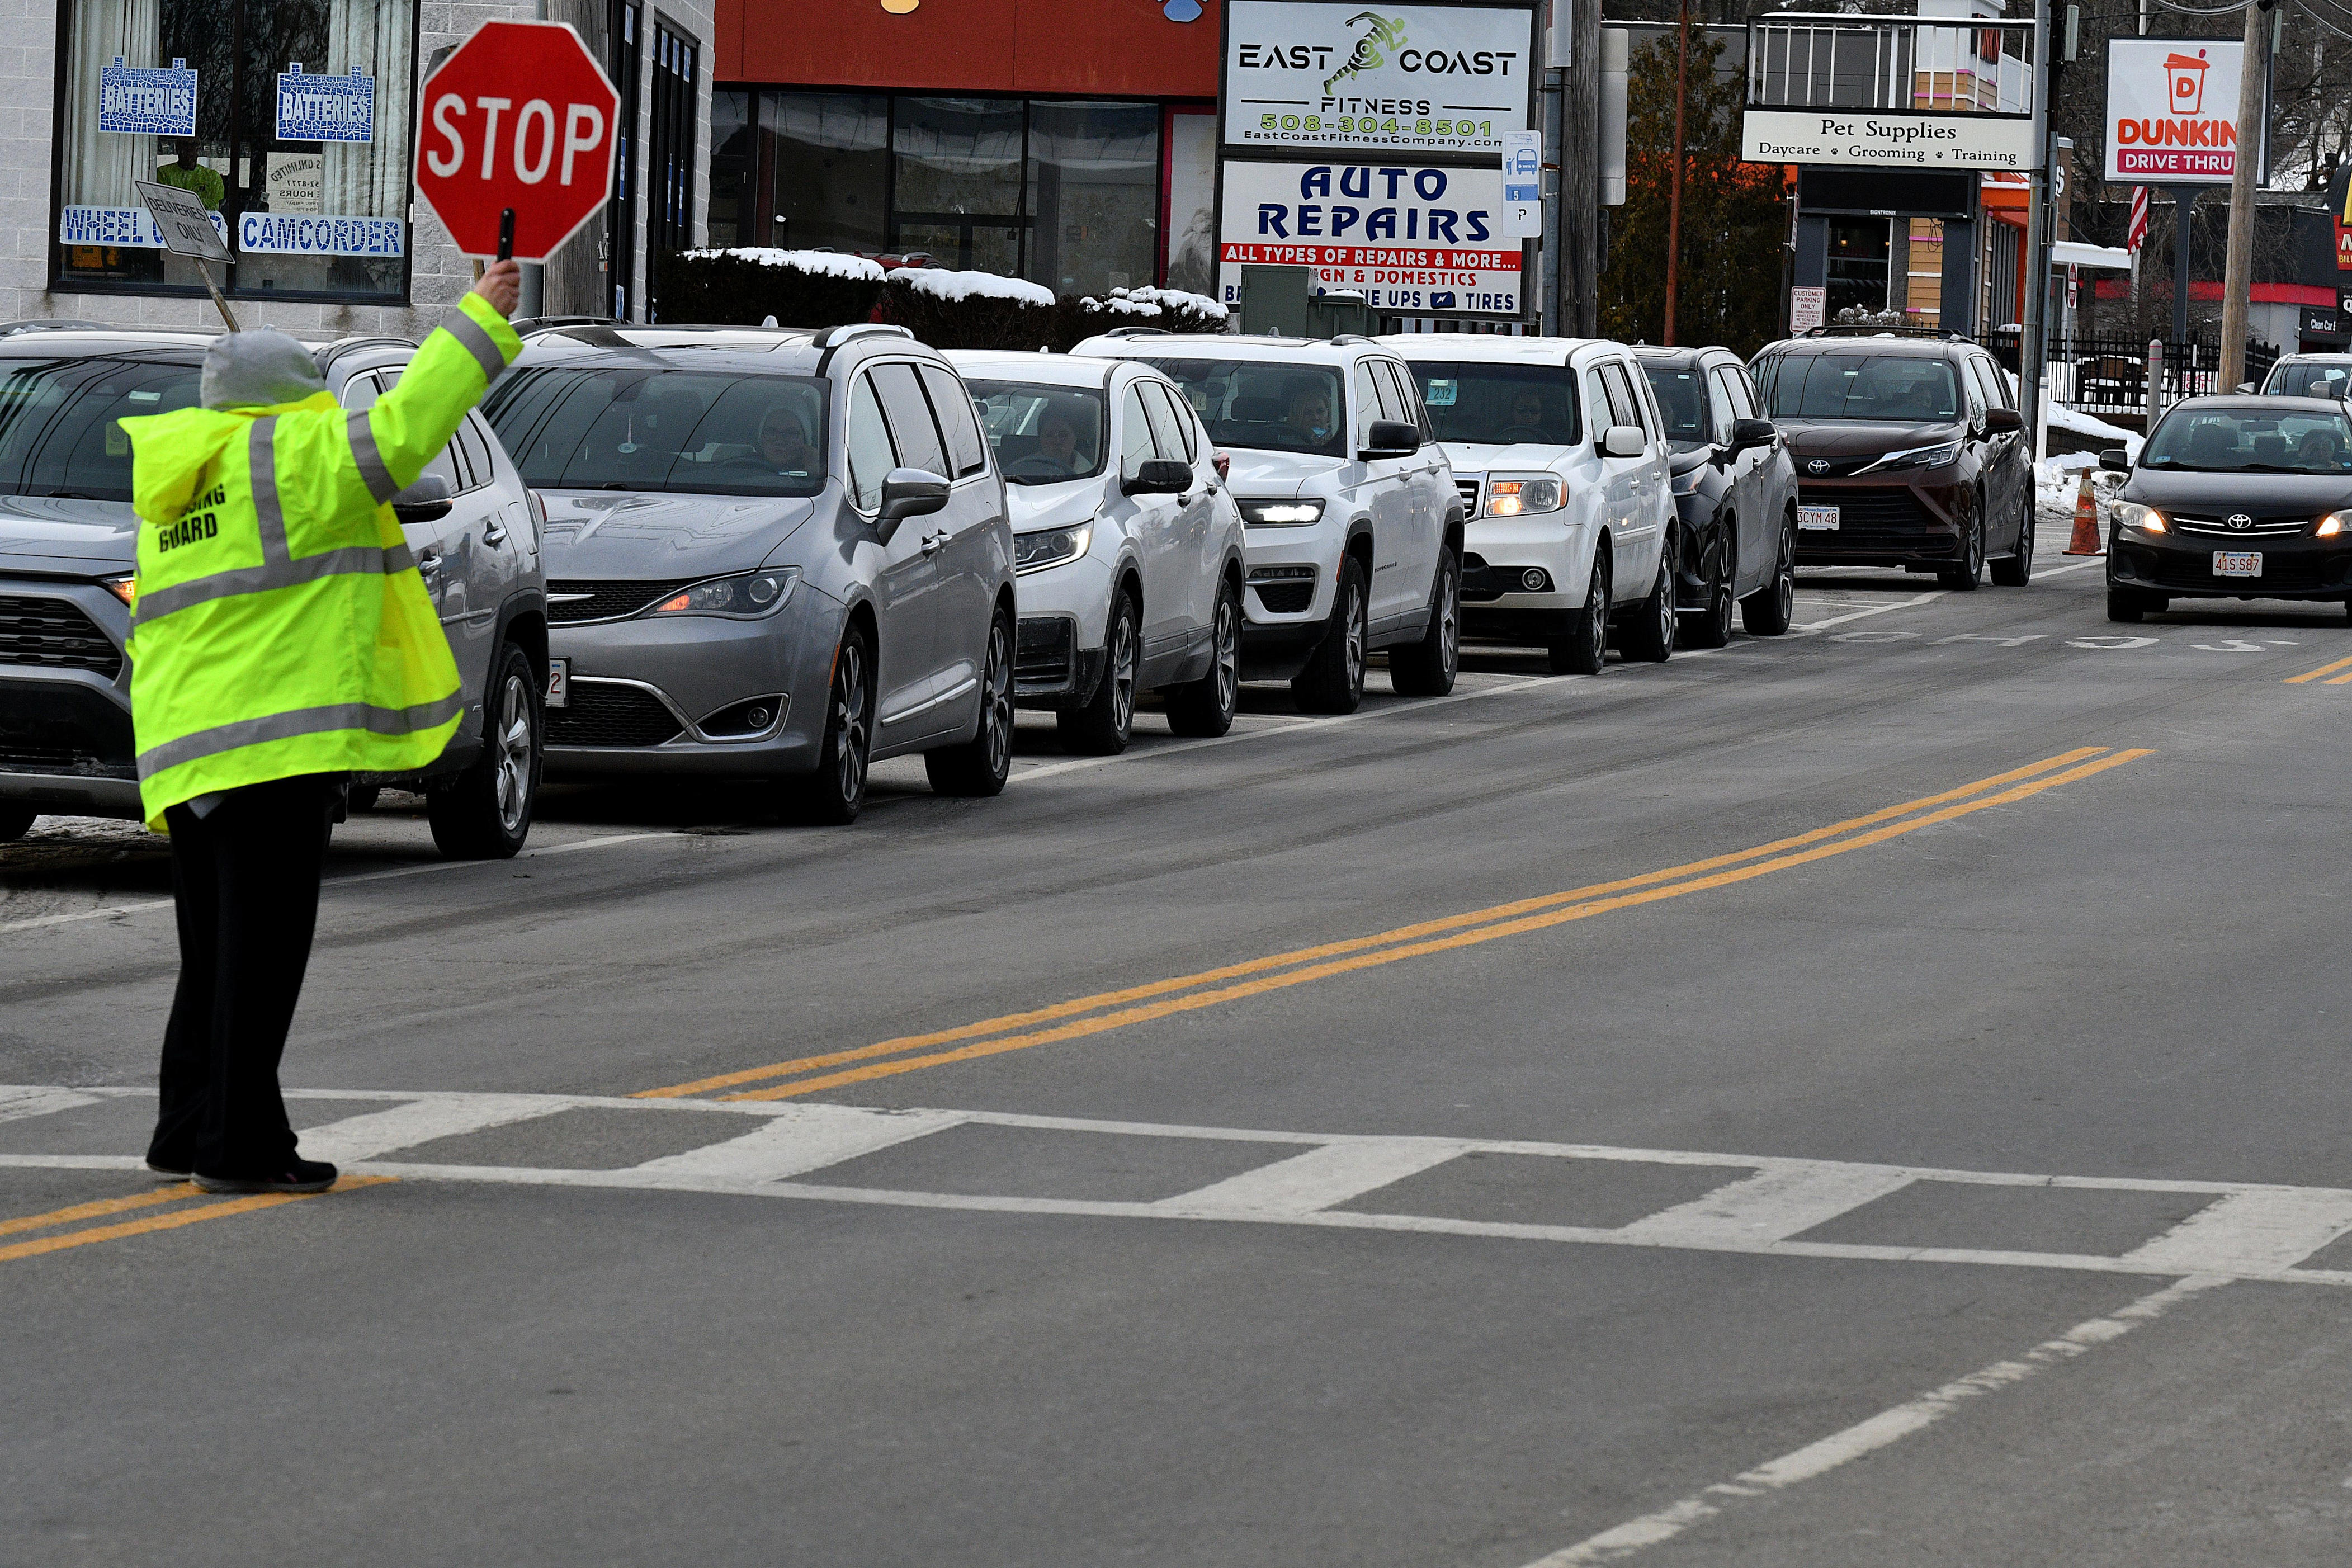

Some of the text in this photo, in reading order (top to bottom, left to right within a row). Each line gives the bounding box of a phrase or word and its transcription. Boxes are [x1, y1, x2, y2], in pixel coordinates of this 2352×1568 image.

[1239, 44, 1517, 75] EAST COAST
[105, 86, 191, 116] BATTERIES
[282, 92, 368, 122] BATTERIES
[1321, 97, 1430, 115] FITNESS
[1260, 114, 1491, 137] 508-304-8501
[1821, 119, 1957, 143] Pet Supplies
[427, 93, 604, 186] STOP
[1759, 142, 2017, 166] Daycare Grooming Training
[2126, 154, 2232, 171] DRIVE THRU
[1300, 167, 1447, 201] AUTO
[147, 197, 206, 222] DELIVERIES
[65, 209, 143, 243] WHEEL
[177, 221, 205, 243] ONLY
[243, 217, 400, 253] CAMCORDER
[1258, 203, 1490, 245] REPAIRS
[1225, 245, 1516, 268] ALL TYPES OF REPAIRS & MORE...
[1375, 270, 1476, 286] DOMESTICS
[1388, 290, 1421, 307] UPS
[1466, 292, 1514, 310] TIRES
[1434, 387, 1451, 399] 232
[1825, 512, 1837, 524] 48
[159, 513, 218, 552] GUARD
[2216, 558, 2259, 571] 41S S87
